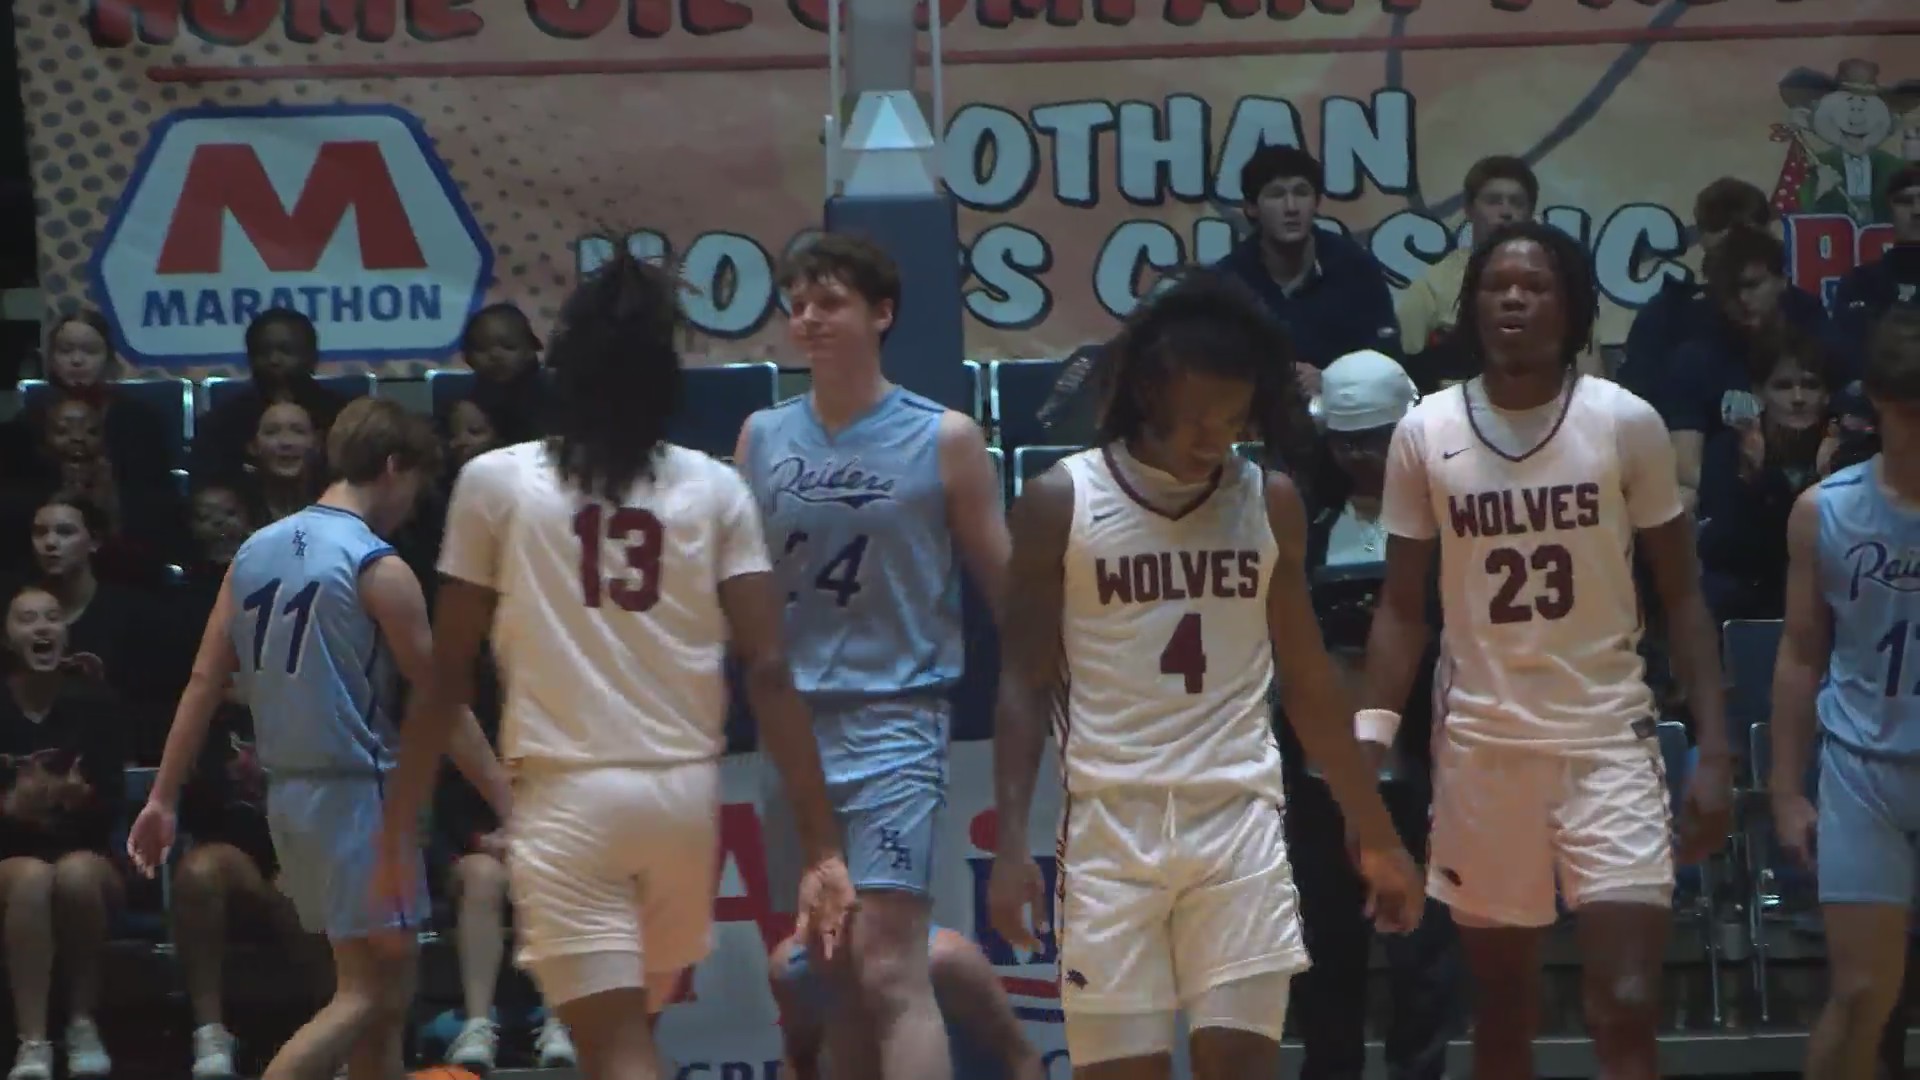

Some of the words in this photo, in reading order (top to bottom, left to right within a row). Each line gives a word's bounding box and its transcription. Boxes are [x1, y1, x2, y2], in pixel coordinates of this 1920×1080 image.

[935, 90, 1417, 212] OTHAN
[141, 283, 442, 328] MARATHON
[769, 455, 896, 512] Raiders
[1448, 482, 1600, 539] WOLVES
[572, 503, 663, 612] 13
[1096, 549, 1261, 605] WOLVES
[1484, 543, 1576, 625] 23
[1843, 541, 1920, 602] Rai
[243, 580, 321, 674] 11
[1159, 612, 1207, 694] 4
